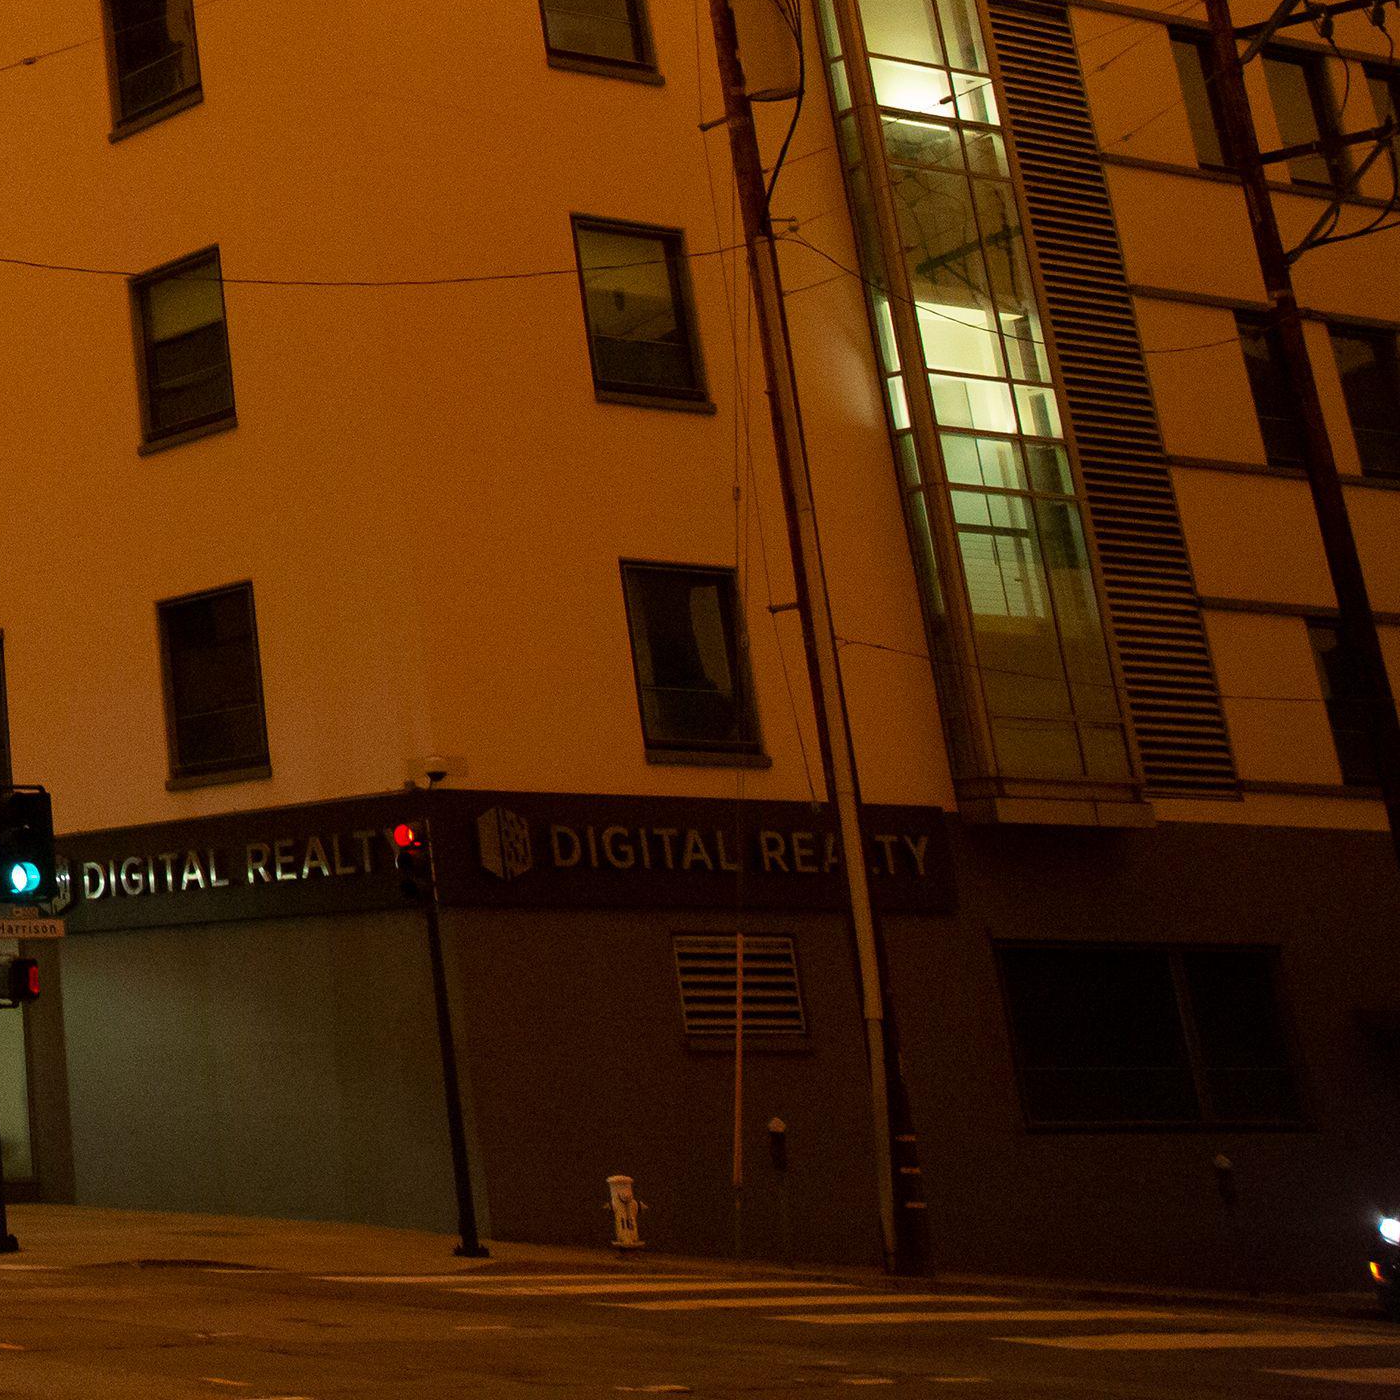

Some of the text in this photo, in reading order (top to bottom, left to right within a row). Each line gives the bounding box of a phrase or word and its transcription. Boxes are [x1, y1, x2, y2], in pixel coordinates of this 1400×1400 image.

[83, 850, 230, 900] DIGITAL
[550, 825, 930, 876] DIGITAL RETY
